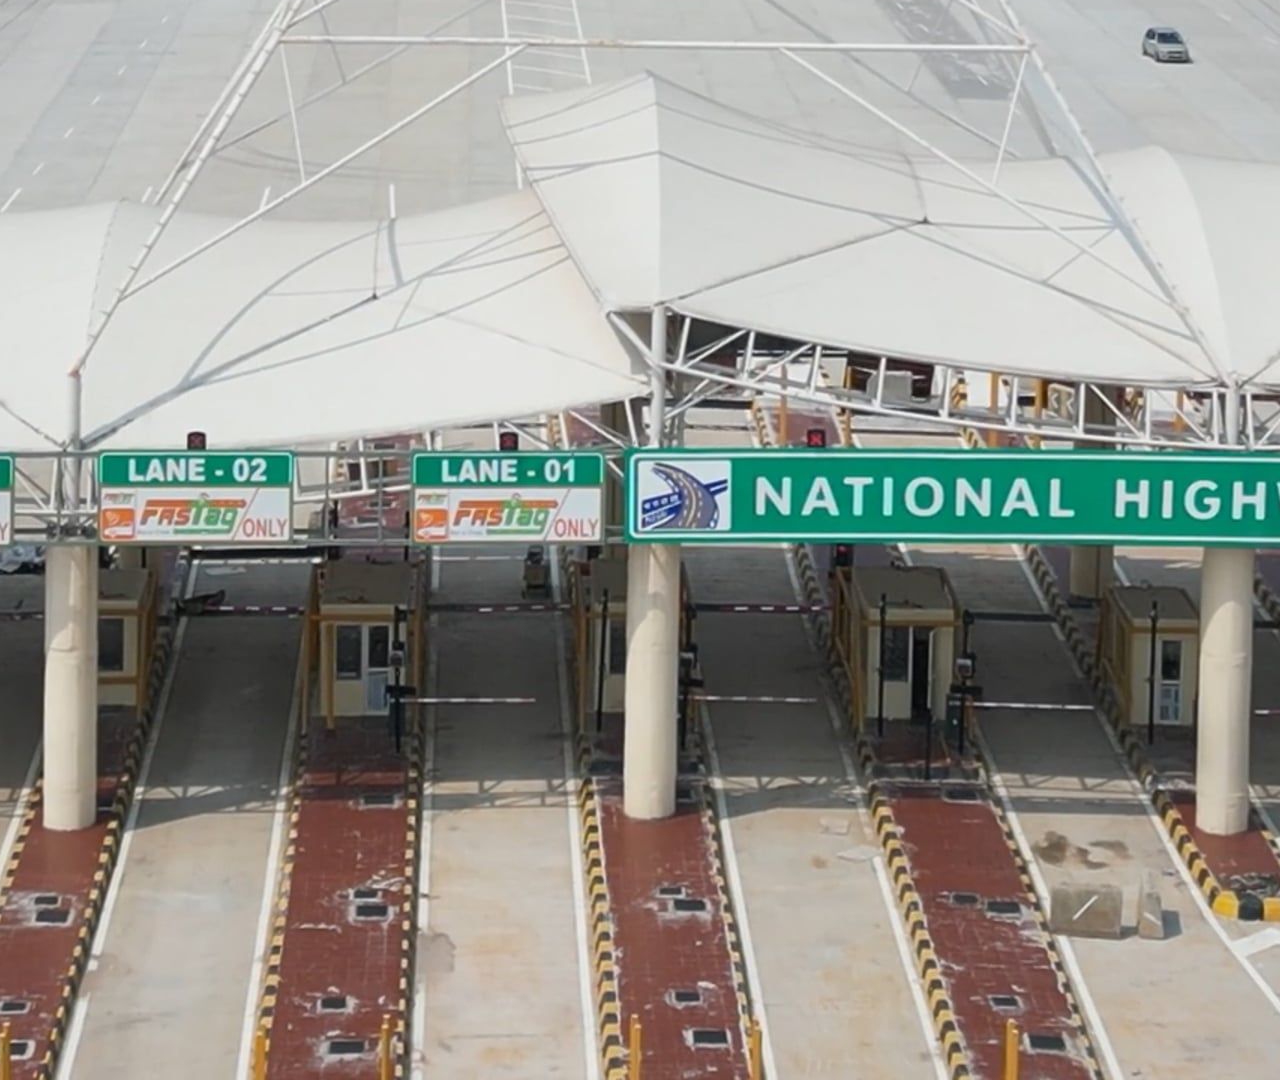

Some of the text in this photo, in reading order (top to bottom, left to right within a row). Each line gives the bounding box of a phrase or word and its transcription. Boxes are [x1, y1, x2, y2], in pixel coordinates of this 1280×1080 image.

[128, 457, 206, 483] LANE
[232, 457, 267, 483] 02
[441, 458, 518, 483] LANE
[544, 458, 575, 483] 01
[755, 476, 1075, 518] NATIONAL
[243, 518, 287, 537] ONLY
[554, 518, 598, 537] ONLY
